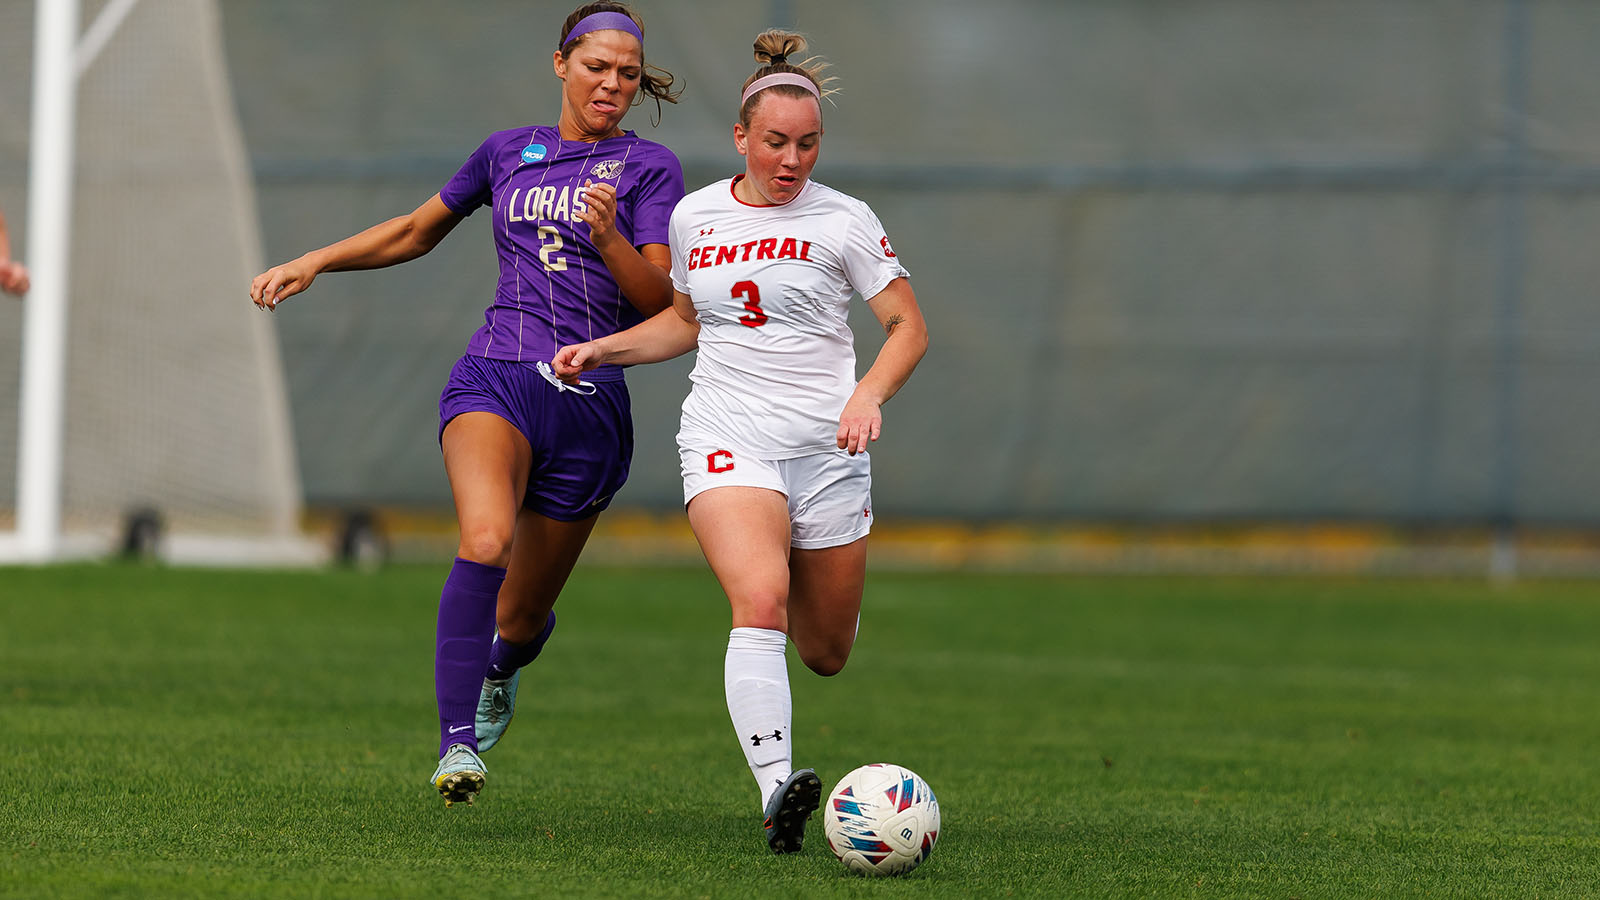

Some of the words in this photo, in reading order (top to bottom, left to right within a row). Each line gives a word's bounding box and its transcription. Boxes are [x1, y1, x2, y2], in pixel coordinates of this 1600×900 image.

[509, 185, 588, 223] LORAS
[537, 225, 568, 271] 2
[688, 237, 814, 271] CENTRAL
[730, 280, 768, 328] 3
[707, 450, 735, 473] C
